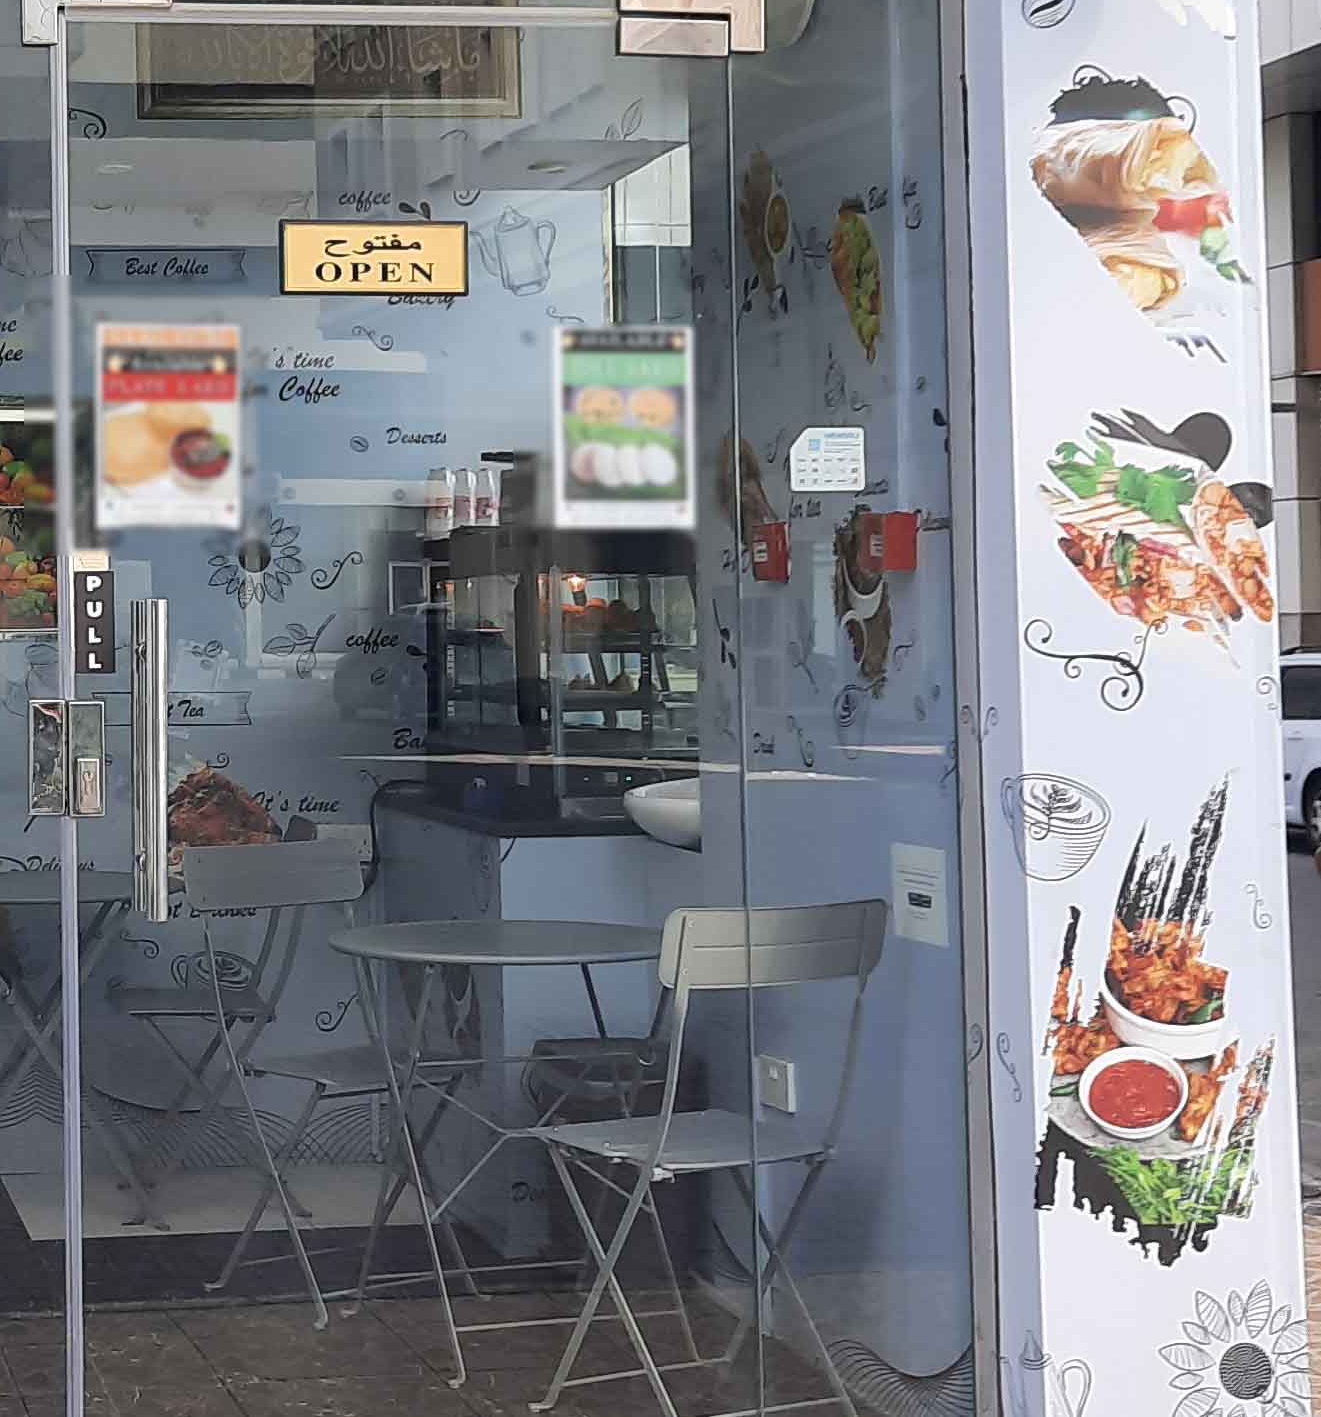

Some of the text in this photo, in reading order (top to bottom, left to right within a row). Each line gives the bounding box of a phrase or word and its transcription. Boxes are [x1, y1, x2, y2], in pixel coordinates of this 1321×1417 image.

[338, 190, 392, 212] coffee
[324, 234, 422, 258] مفتوح
[125, 257, 209, 279] Best Coffee
[315, 261, 435, 283] OPEN
[294, 352, 335, 369] time
[278, 375, 341, 404] Coffee
[386, 426, 448, 446] Desserts
[85, 575, 103, 670] PULL
[345, 628, 400, 658] coffee
[177, 699, 205, 719] Tea
[298, 793, 341, 813] time
